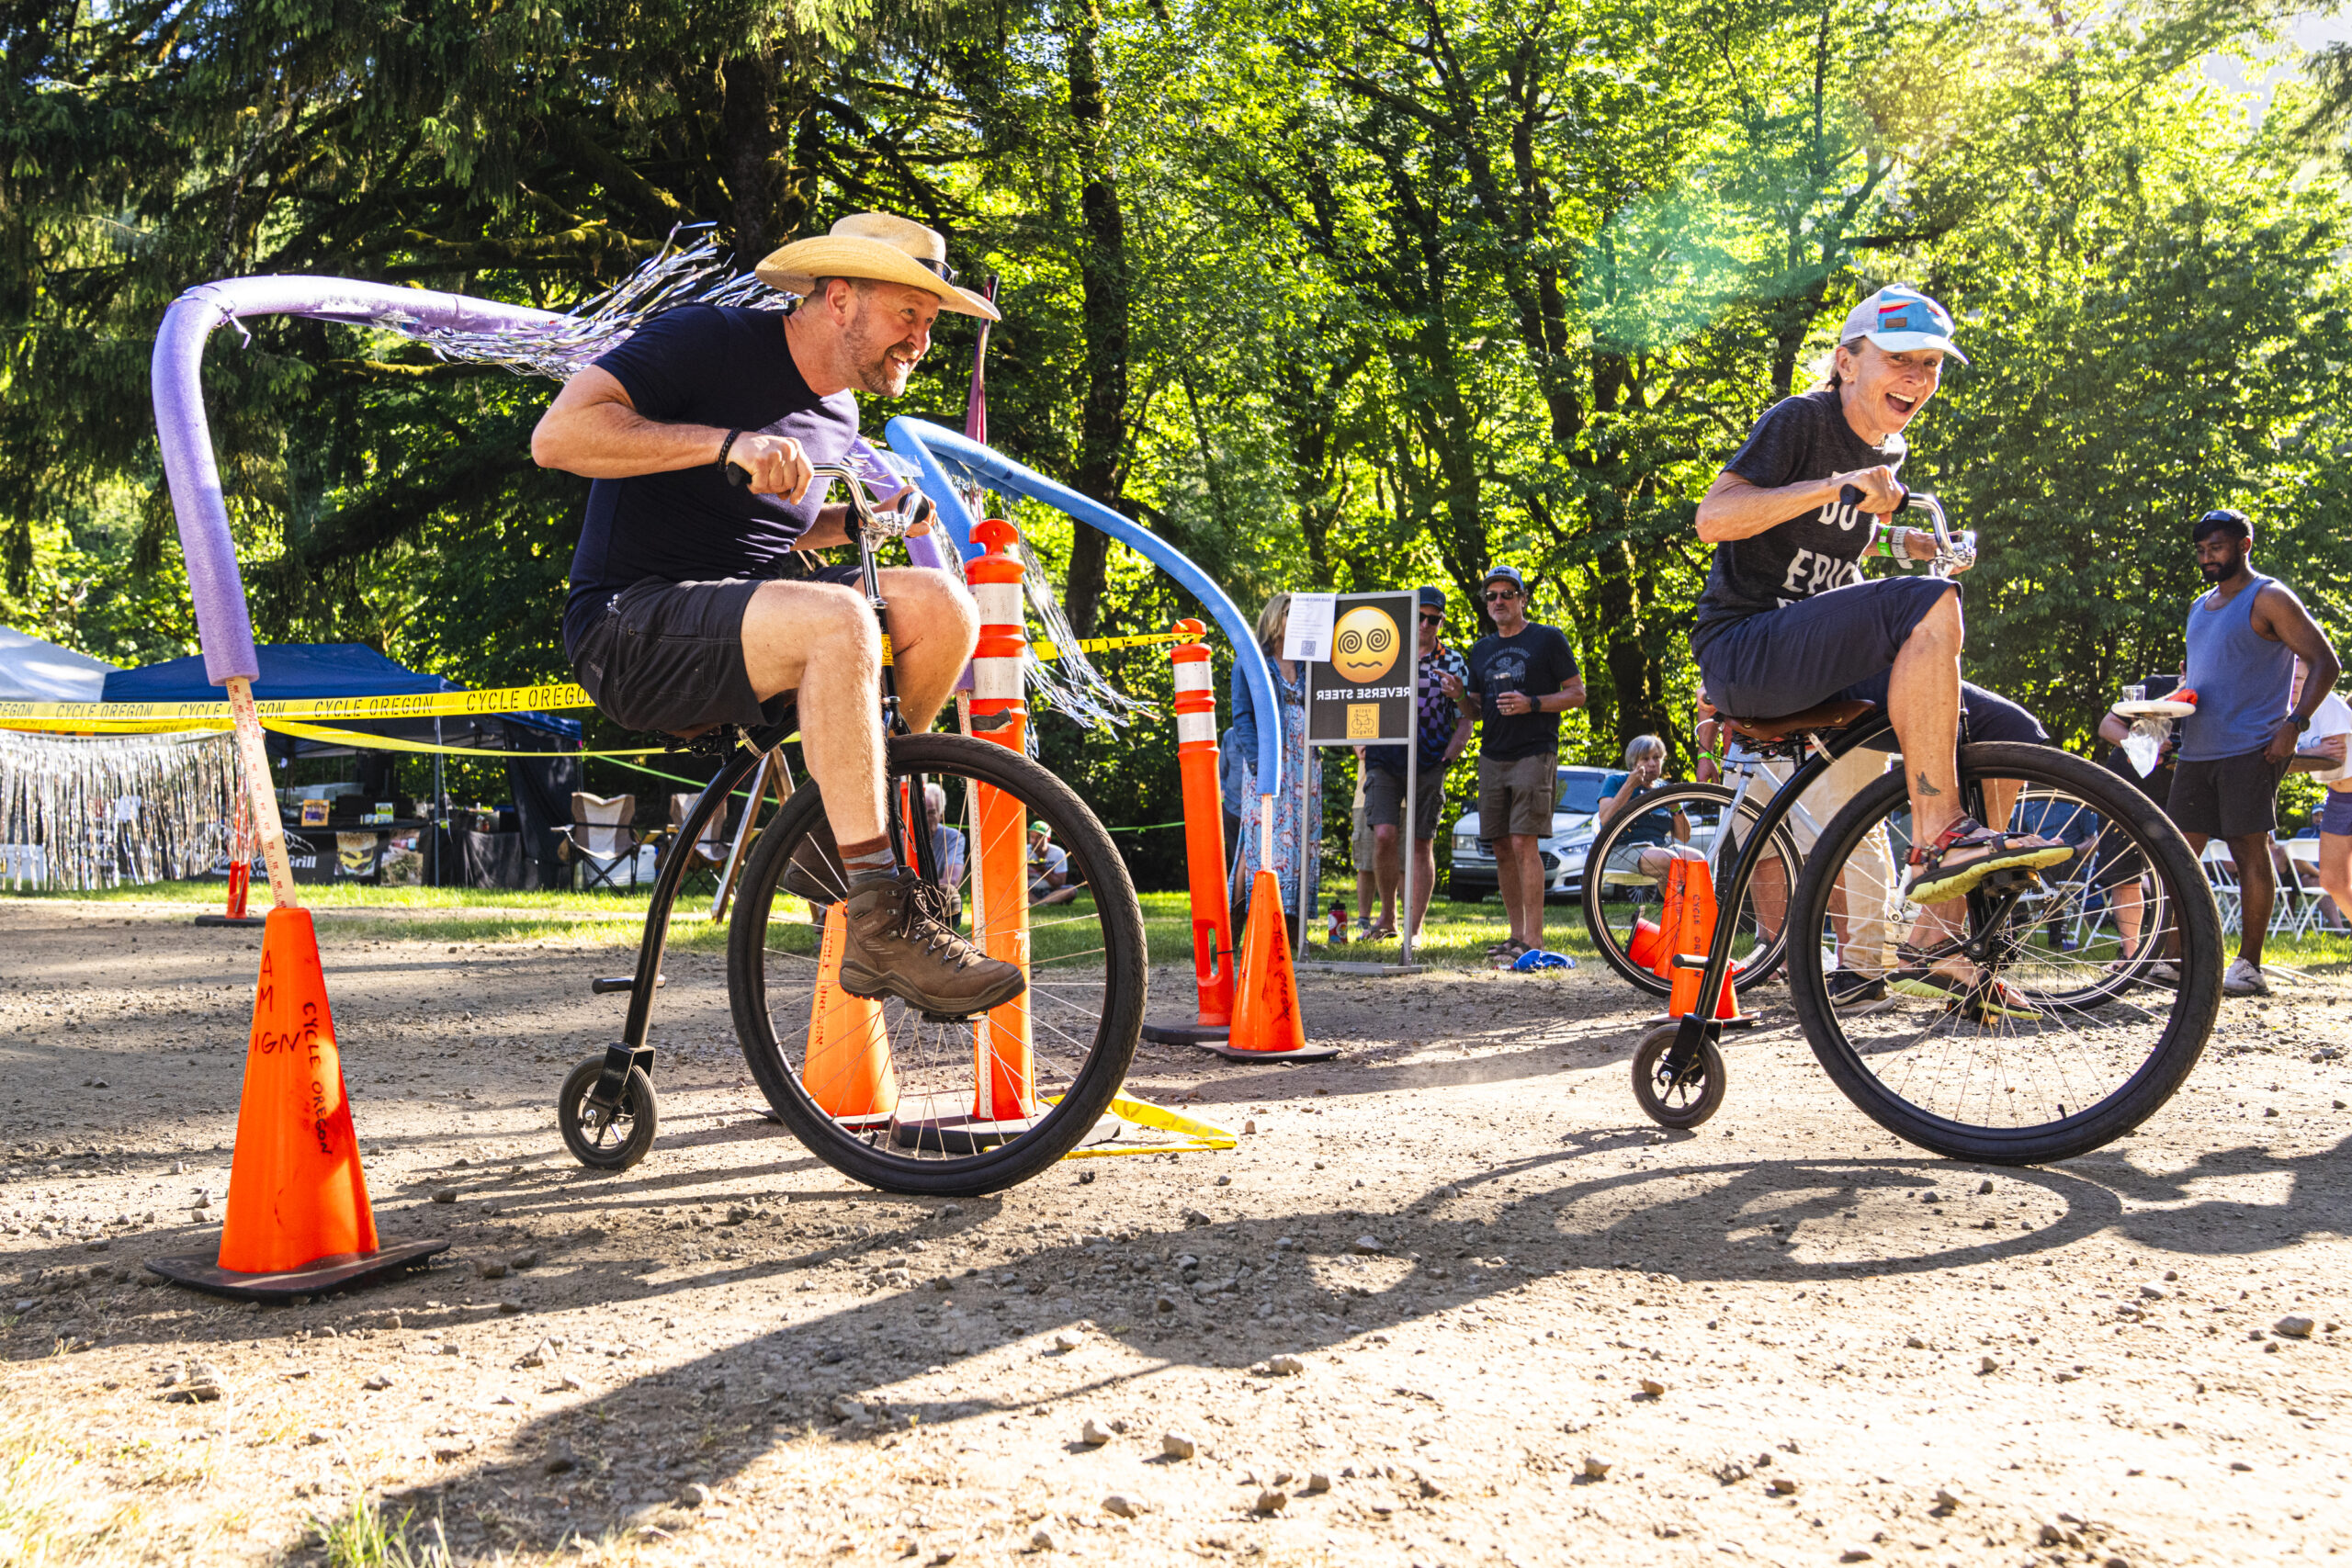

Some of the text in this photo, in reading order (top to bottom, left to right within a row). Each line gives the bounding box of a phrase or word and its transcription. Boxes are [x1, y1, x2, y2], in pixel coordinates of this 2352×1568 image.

[56, 705, 96, 718] CYCLE
[101, 705, 153, 718] OREGON
[178, 703, 222, 719] CYCLE
[314, 699, 362, 717] CYCLE
[369, 695, 434, 716] OREGON
[467, 691, 520, 711] CYCLE
[528, 687, 593, 707] OREGO
[302, 1002, 333, 1155] CYCLE OREGON
